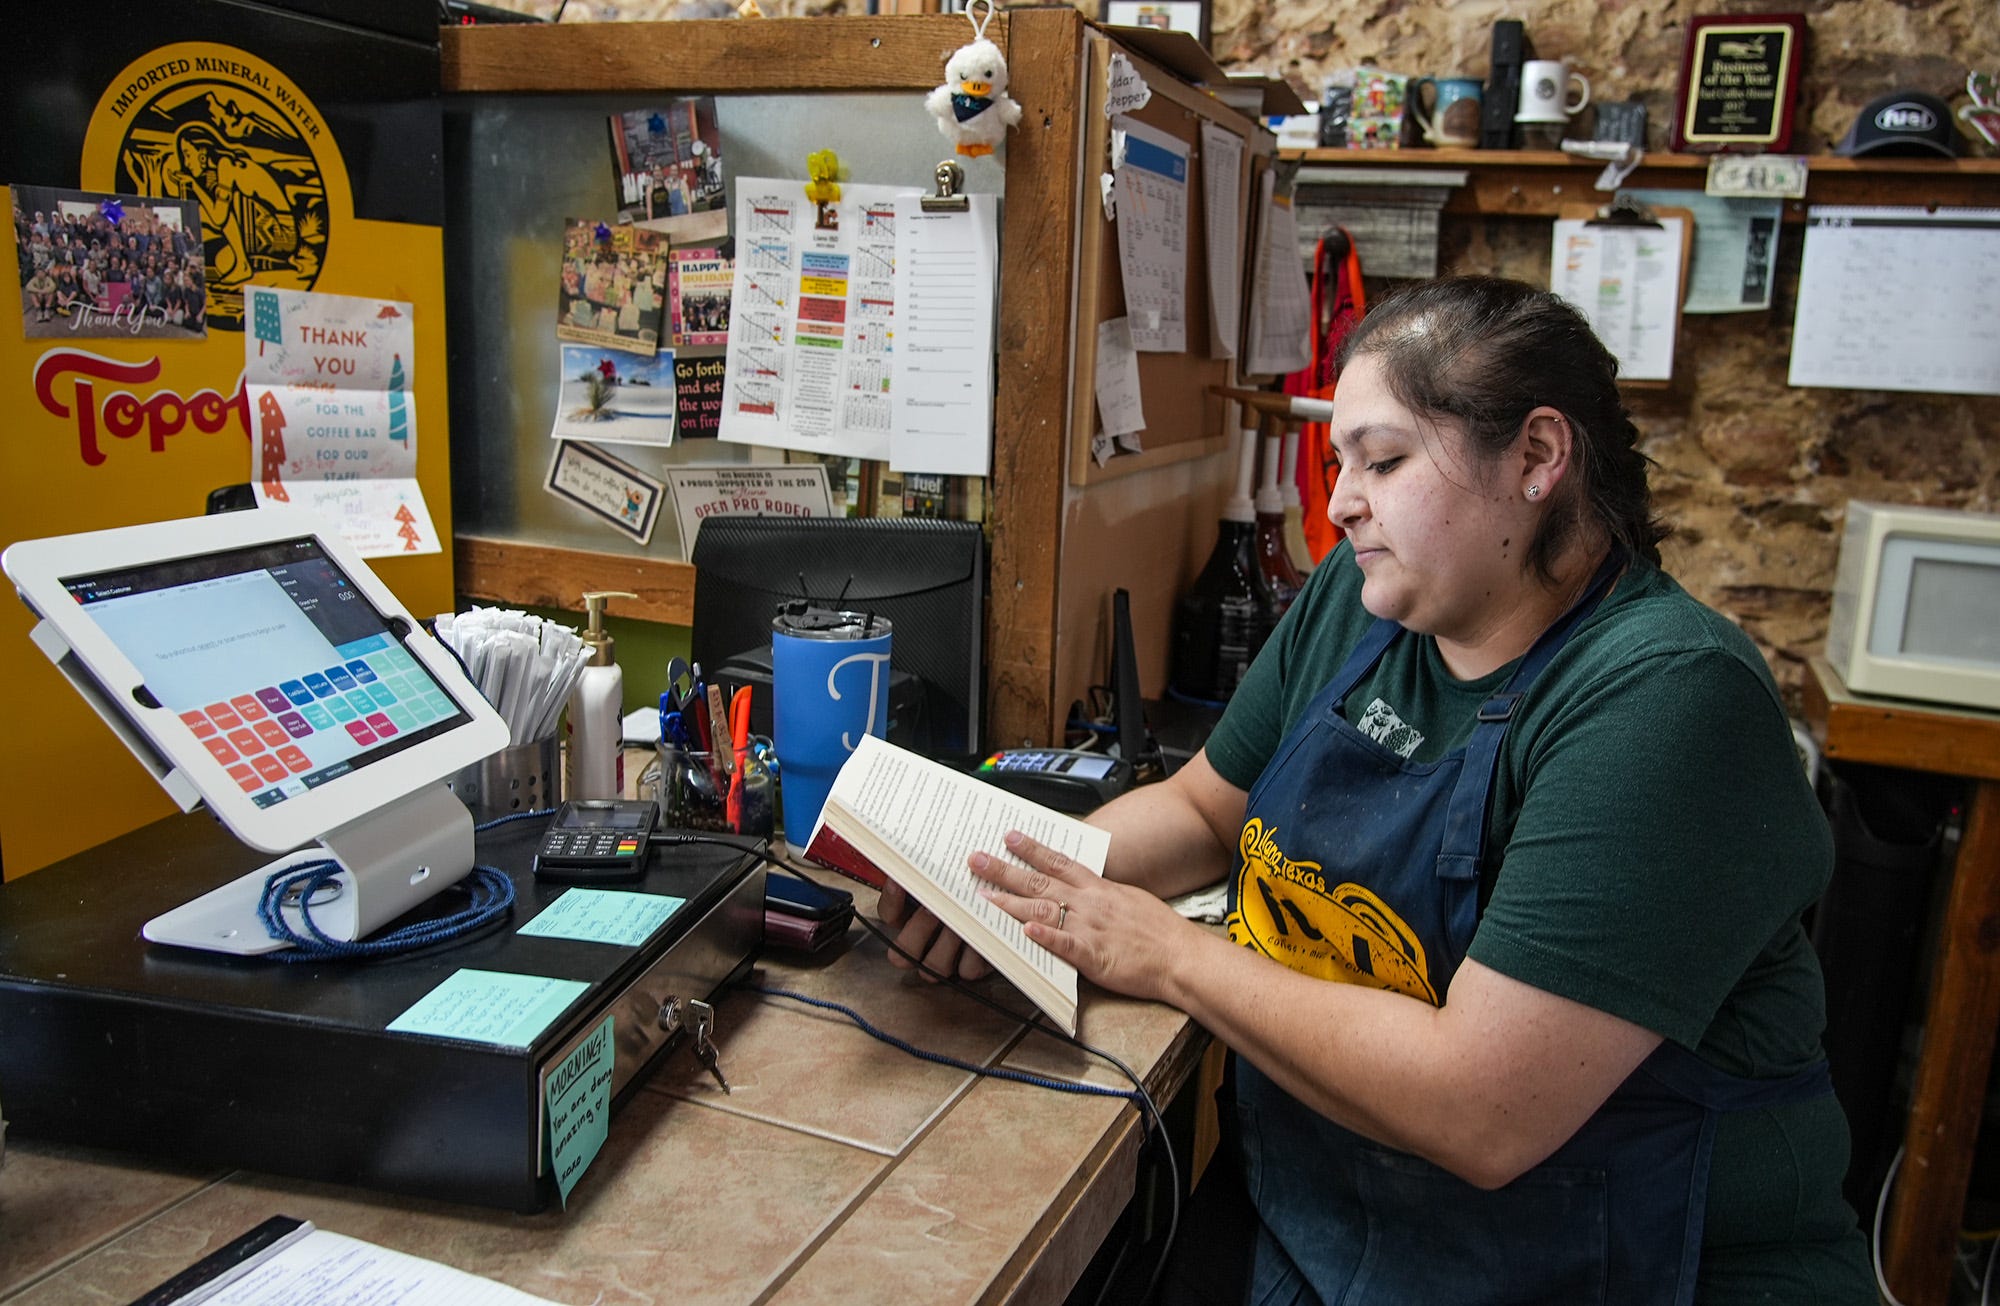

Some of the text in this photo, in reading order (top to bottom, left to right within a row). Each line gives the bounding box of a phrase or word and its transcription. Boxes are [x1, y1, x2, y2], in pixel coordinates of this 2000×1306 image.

[110, 56, 321, 141] IMPORTED MINERAL WATER
[1111, 93, 1147, 107] Pepper
[1883, 109, 1929, 127] fuel
[683, 263, 721, 273] HAPPY
[683, 272, 735, 283] HOLIDAY
[67, 301, 122, 331] Thank
[300, 326, 367, 348] THANK
[313, 356, 356, 375] YOU
[676, 361, 725, 378] Go forth
[678, 379, 721, 394] and set
[33, 347, 229, 466] Topo
[316, 404, 364, 415] FOR THE
[679, 399, 698, 412] the
[307, 427, 377, 438] COFFEE BAR
[681, 418, 697, 429] on
[316, 449, 368, 460] FOR OUR
[715, 479, 762, 488] SUPPORTER
[913, 474, 941, 494] fuel
[694, 498, 812, 519] OPEN PRO RODEO
[1281, 856, 1325, 893] Texas
[550, 1025, 607, 1105] MORNING!
[571, 1091, 587, 1112] are
[555, 1108, 594, 1159] amazing
